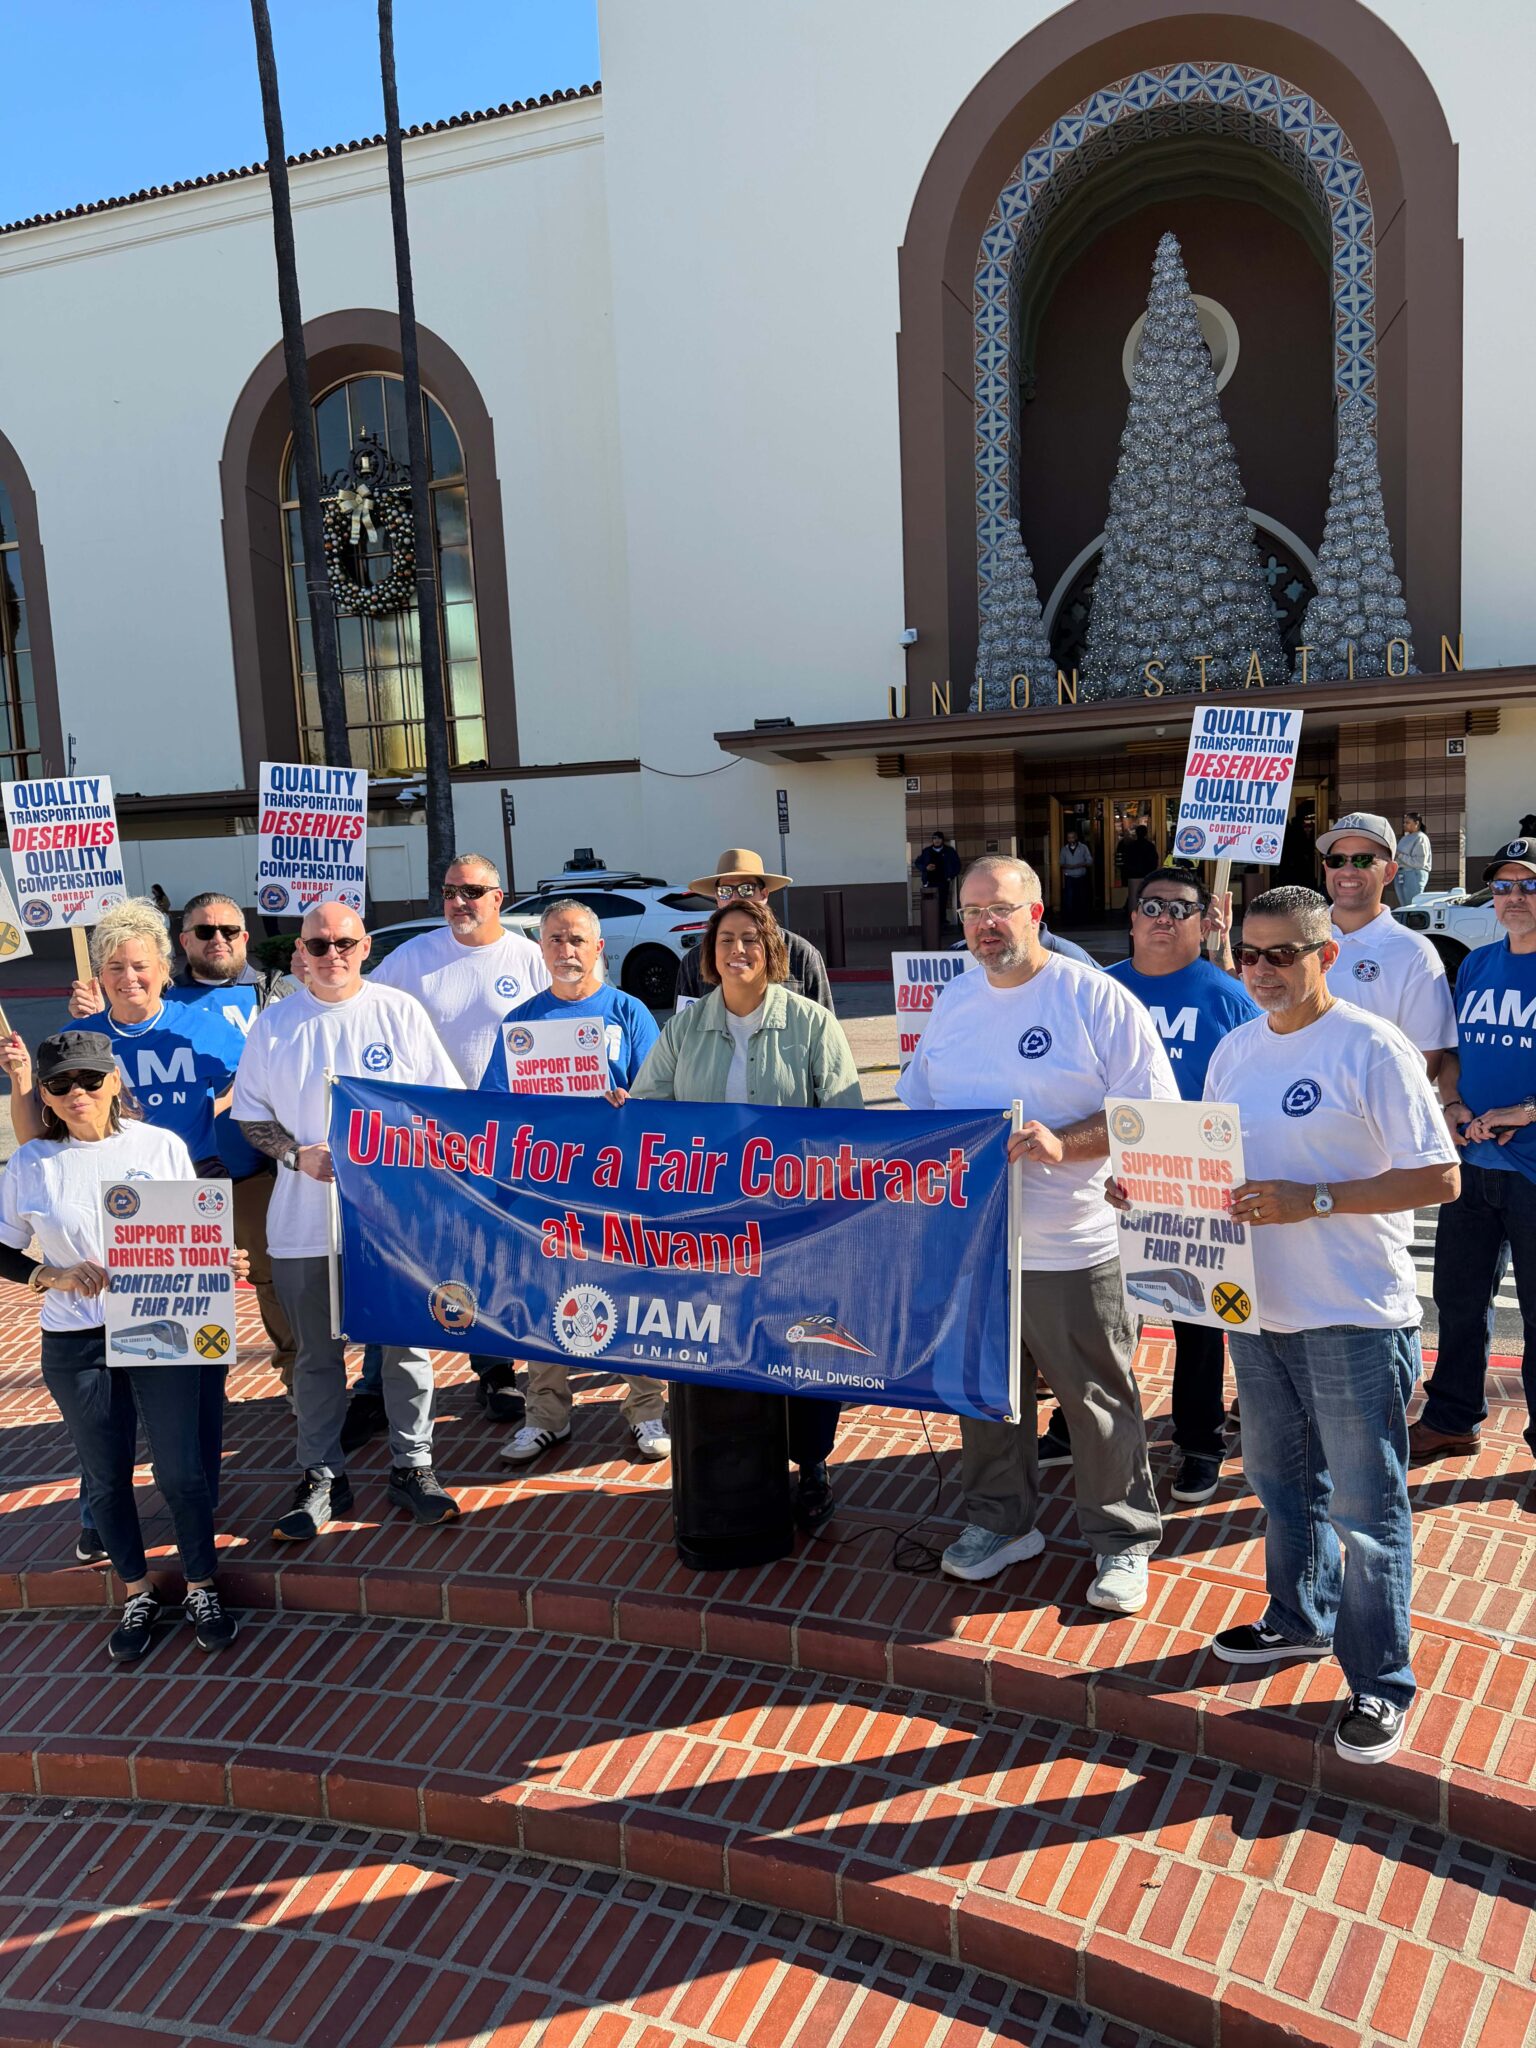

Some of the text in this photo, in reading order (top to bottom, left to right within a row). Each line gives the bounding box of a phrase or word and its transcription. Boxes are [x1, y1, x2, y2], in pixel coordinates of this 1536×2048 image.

[888, 633, 1464, 719] UNION STATION
[1203, 709, 1292, 737] QUALITY
[1194, 736, 1294, 754] TRANSPORTATION
[1186, 753, 1294, 781] DESERVES
[271, 766, 357, 795] QUALITY
[1194, 778, 1279, 806] QUALITY
[14, 779, 100, 809] QUALITY
[264, 793, 362, 812] TRANSPORTATION
[10, 805, 111, 825] TRANSPORTATION
[260, 811, 364, 839] DESERVES
[1180, 803, 1286, 825] COMPENSATION
[12, 822, 114, 852] DESERVES
[1209, 824, 1252, 834] CONTRACT
[1217, 836, 1240, 845] NOW!
[25, 846, 107, 876] QUALITY
[272, 836, 354, 863] QUALITY
[18, 870, 123, 894] COMPENSATION
[260, 861, 364, 881] COMPENSATION
[52, 890, 94, 902] CONTRACT
[291, 881, 333, 892] CONTRACT
[302, 892, 322, 902] NOW!
[64, 902, 86, 912] NOW!
[907, 958, 964, 982] UNION
[1459, 989, 1536, 1029] IAM
[1464, 1032, 1532, 1048] UNION
[516, 1055, 599, 1076] SUPPORT BUS
[512, 1074, 606, 1094] DRIVERS TODAY
[348, 1108, 970, 1208] United for a Fair Contract
[1121, 1151, 1233, 1184] SUPPORT BUS
[1117, 1177, 1238, 1211] DRIVERS TODA
[114, 1225, 222, 1244] SUPPORT BUS
[1120, 1209, 1246, 1245] CONTRACT AND
[541, 1211, 762, 1277] at Alvand
[1144, 1237, 1225, 1270] FAIR PAY!
[108, 1247, 230, 1267] DRIVERS TODAY
[110, 1273, 230, 1293] CONTRACT AND
[131, 1297, 211, 1316] FAIR PAY!
[1214, 1295, 1248, 1311] R R
[626, 1296, 722, 1344] IAM
[197, 1337, 228, 1345] R R
[634, 1344, 708, 1364] UNION
[768, 1364, 884, 1390] IAM RAIL DIVISION
